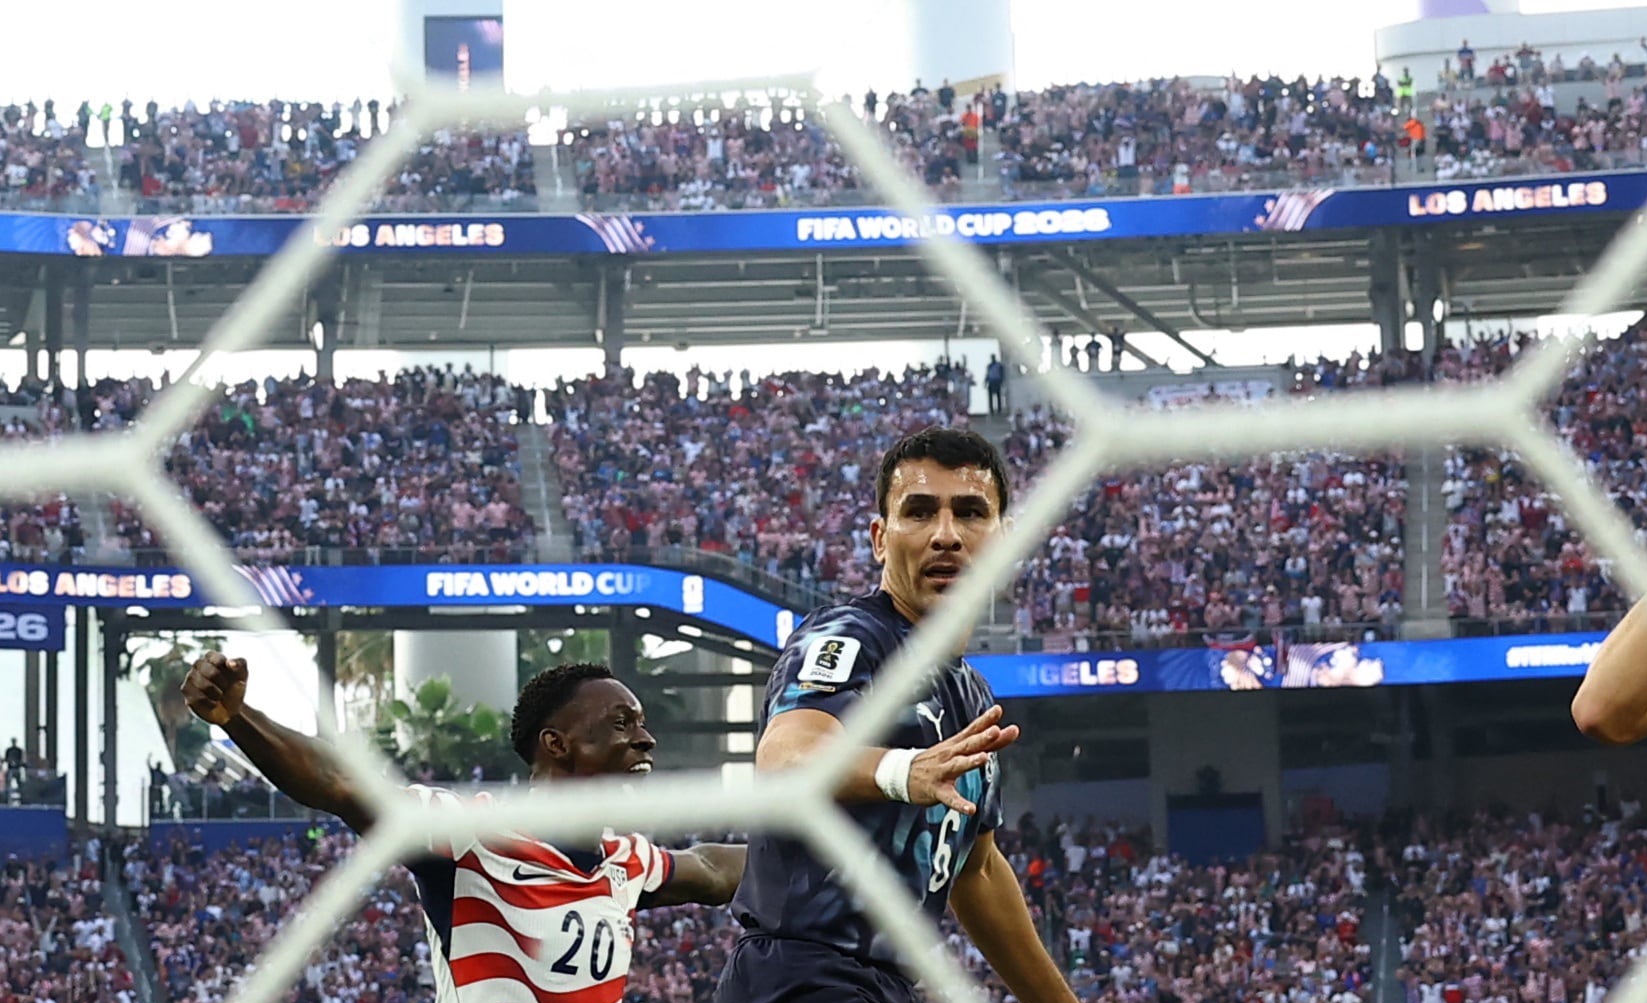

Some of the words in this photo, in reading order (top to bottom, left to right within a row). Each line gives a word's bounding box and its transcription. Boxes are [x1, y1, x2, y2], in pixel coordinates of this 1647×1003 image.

[1409, 190, 1467, 216] LOS
[1472, 181, 1607, 212] ANGELES
[375, 223, 504, 247] ANGELES
[797, 216, 856, 241] FIFA
[857, 213, 955, 239] WORLD
[956, 212, 1012, 237] CUP
[54, 571, 191, 598] ANGELES
[427, 572, 488, 597] FIFA
[490, 572, 593, 597] WORLD
[550, 910, 615, 981] 20
